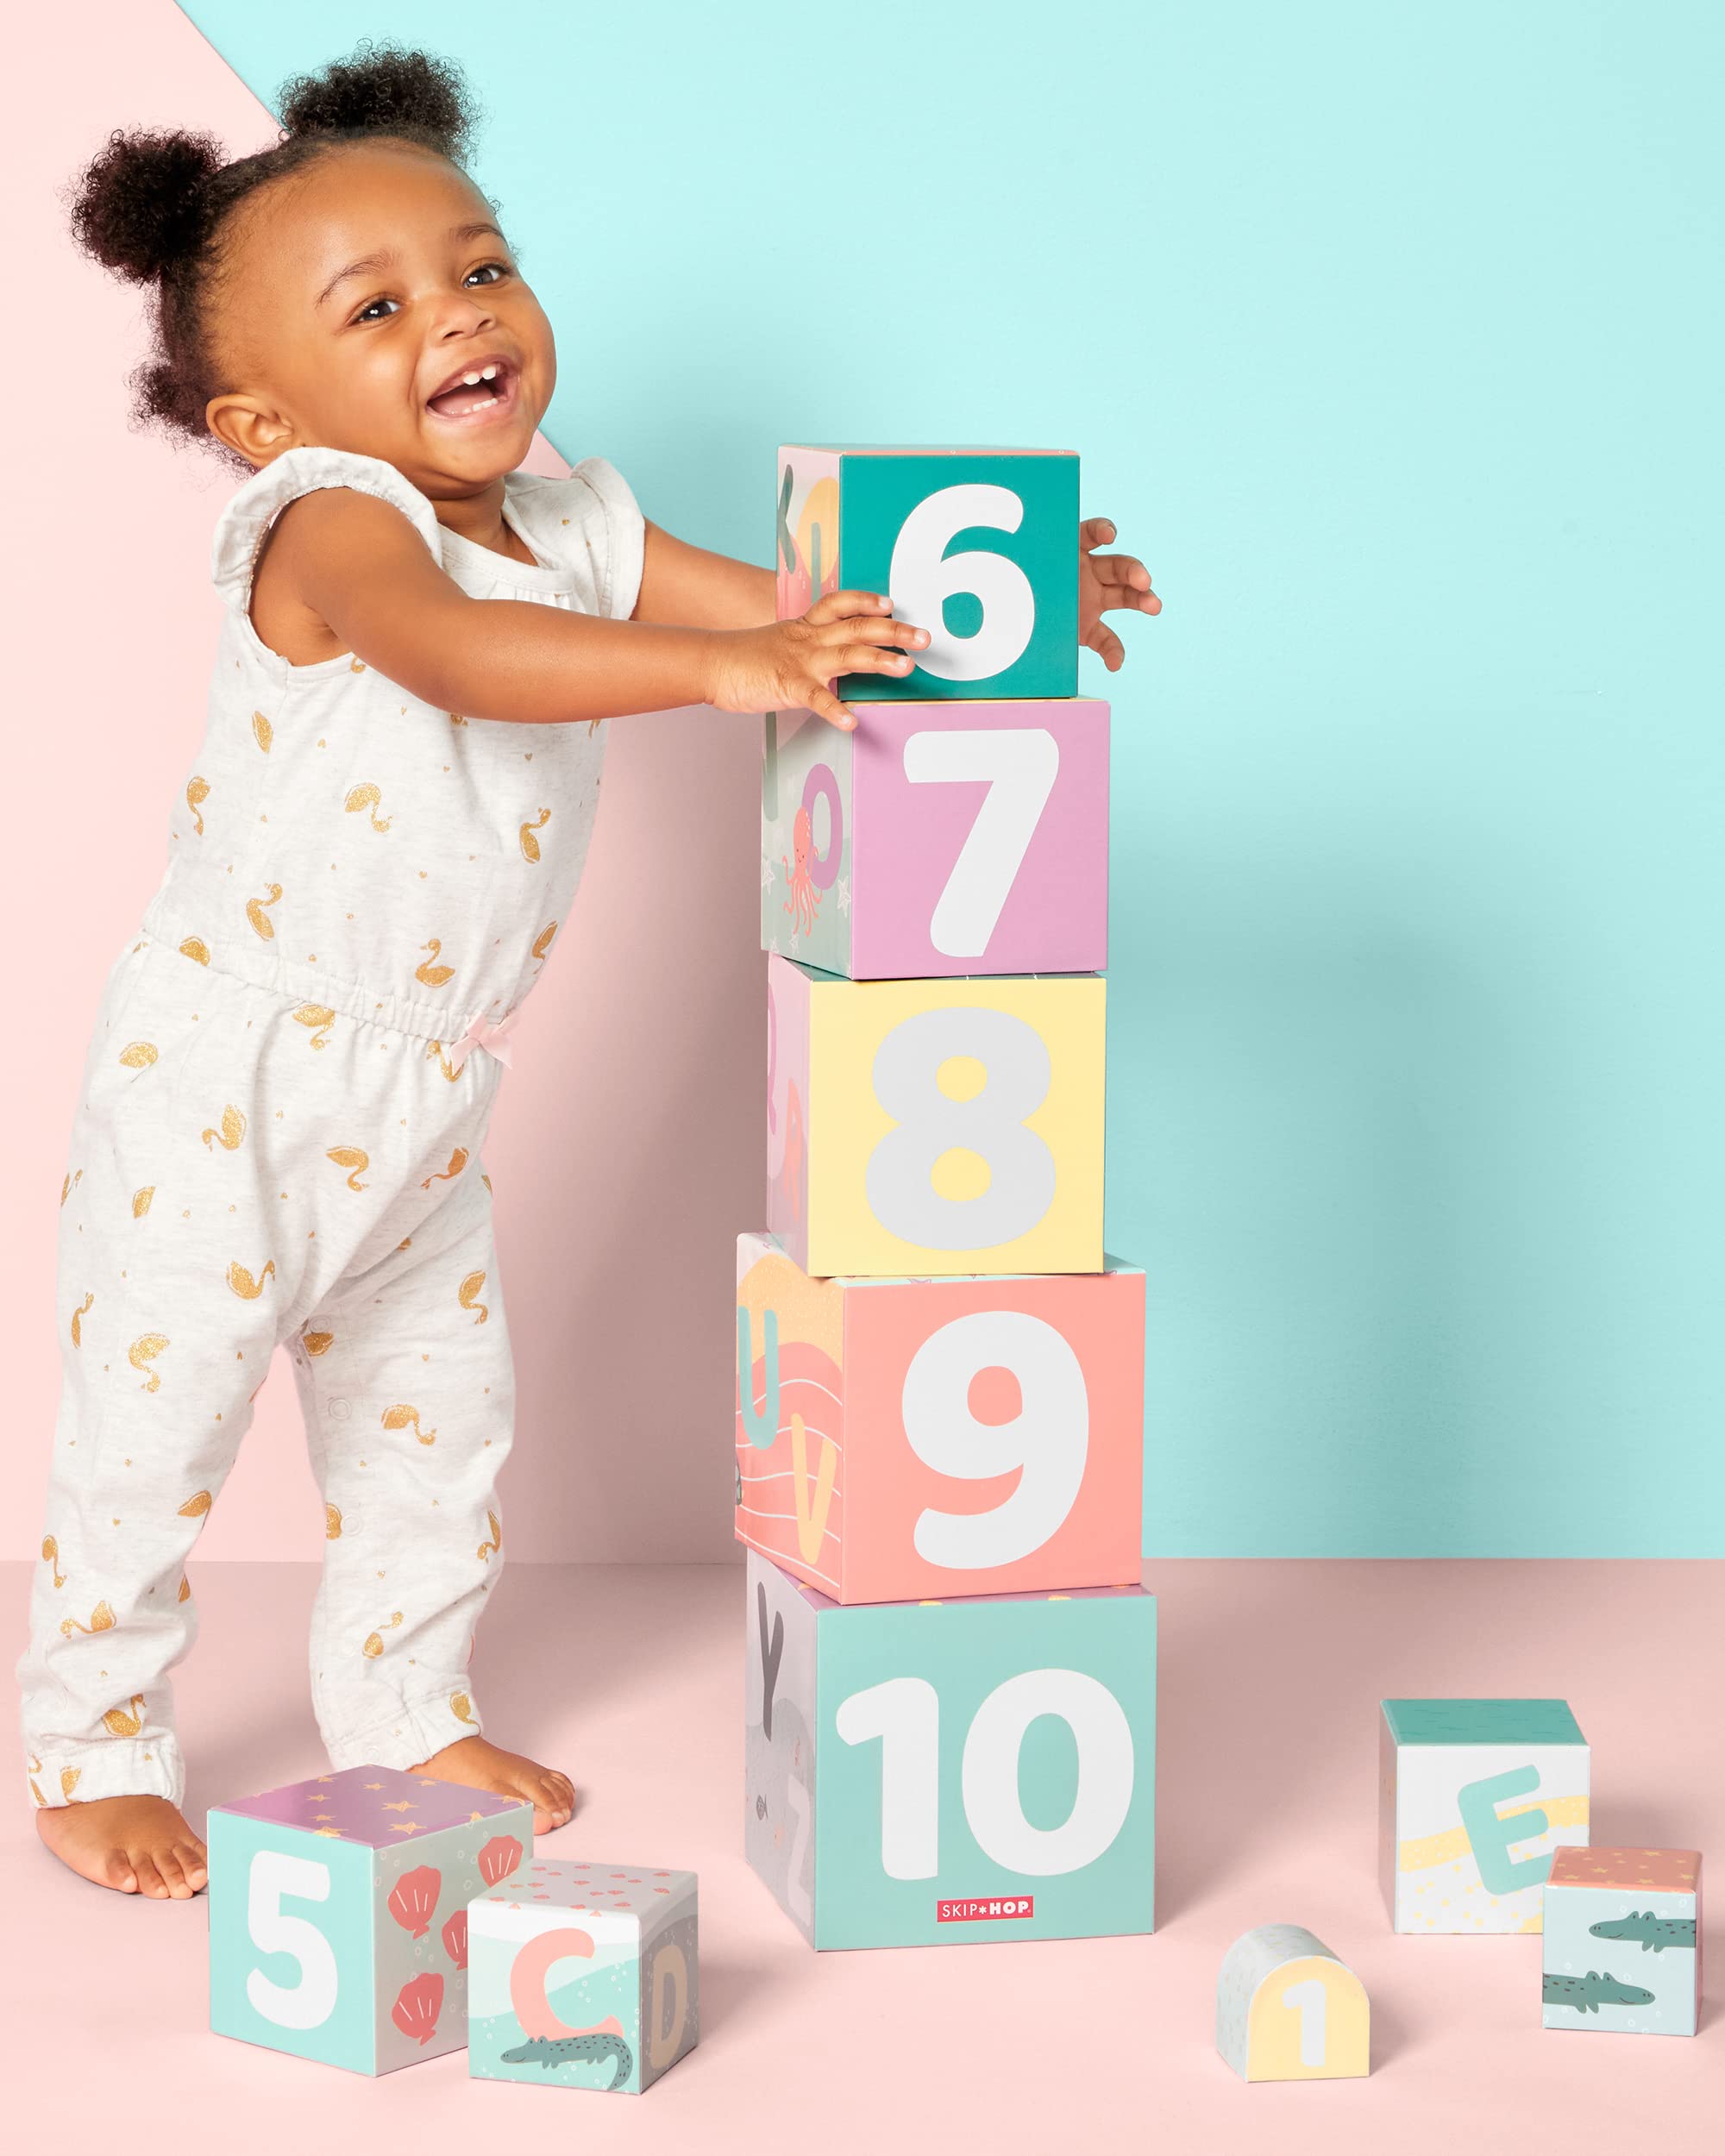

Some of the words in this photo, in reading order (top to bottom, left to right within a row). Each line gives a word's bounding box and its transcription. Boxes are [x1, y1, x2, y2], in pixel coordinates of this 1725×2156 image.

[890, 484, 1035, 680] 6
[801, 763, 844, 890] O
[904, 729, 1060, 956] 7
[866, 1006, 1057, 1250] 8
[737, 1306, 780, 1450] U
[902, 1310, 1089, 1570] 9
[791, 1413, 837, 1565] V
[757, 1581, 784, 1742] Y
[836, 1668, 1134, 1880] 10
[1458, 1764, 1550, 1896] E
[247, 1851, 338, 2030] 5
[511, 1928, 624, 2041] C
[650, 1945, 688, 2070] D
[1283, 1980, 1327, 2067] 1
